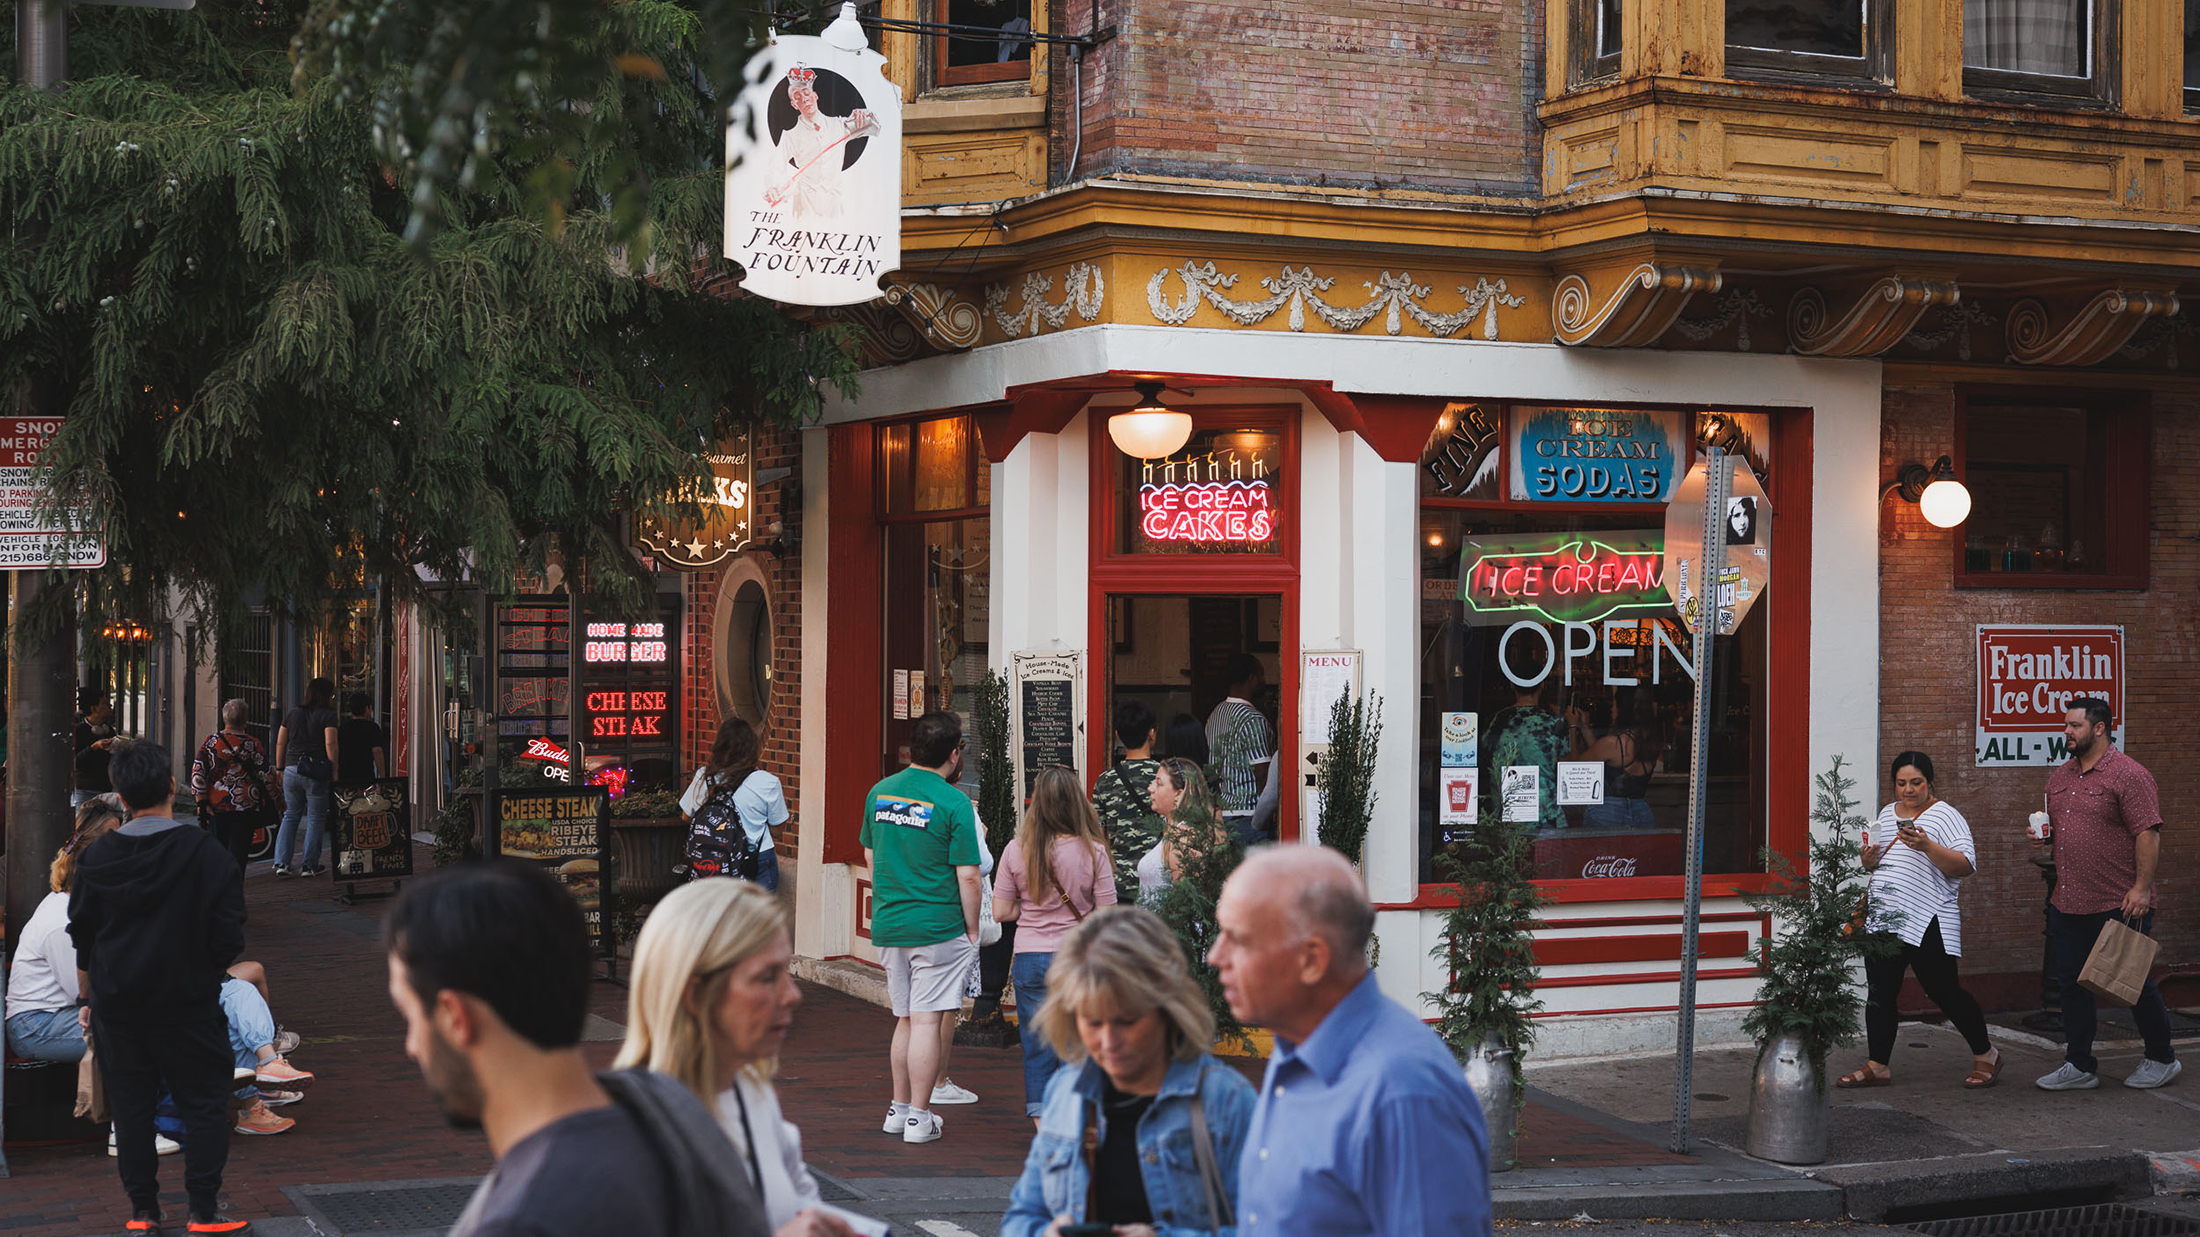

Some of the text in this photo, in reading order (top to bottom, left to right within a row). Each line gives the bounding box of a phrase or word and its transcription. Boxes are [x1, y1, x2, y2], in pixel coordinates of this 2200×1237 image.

[750, 211, 783, 223] THE
[743, 227, 881, 257] FRANKLIN
[749, 252, 881, 281] FOUNTAIN
[15, 422, 65, 434] SNO
[1567, 419, 1632, 437] ICE
[1423, 408, 1498, 491] FINE
[1535, 439, 1660, 459] CREAM
[0, 478, 35, 486] HAINS
[1537, 462, 1660, 498] SODAS
[1141, 490, 1267, 510] ICE CREAM
[0, 520, 34, 529] OWING
[1143, 510, 1270, 541] CAKES
[0, 543, 97, 552] NFORMATION
[1426, 579, 1457, 590] ORDE
[1491, 566, 1543, 597] ICE
[509, 608, 569, 622] CHEES
[587, 623, 626, 637] HOME
[585, 641, 667, 662] BURGER
[1499, 620, 1700, 687] OPEN
[1309, 657, 1352, 667] MENU
[1990, 645, 2113, 680] Franklin
[502, 678, 569, 714] BREAKF
[586, 692, 667, 711] CHEESE
[1993, 683, 2028, 714] Ice
[593, 716, 661, 736] STEAK
[543, 766, 569, 782] OPE
[501, 796, 598, 820] CHEESE STEAK
[875, 810, 926, 827] patagonia
[358, 830, 387, 845] BEER
[551, 825, 597, 836] RIBEYE
[555, 835, 598, 846] STEAK
[541, 847, 599, 856] HANDSLICED
